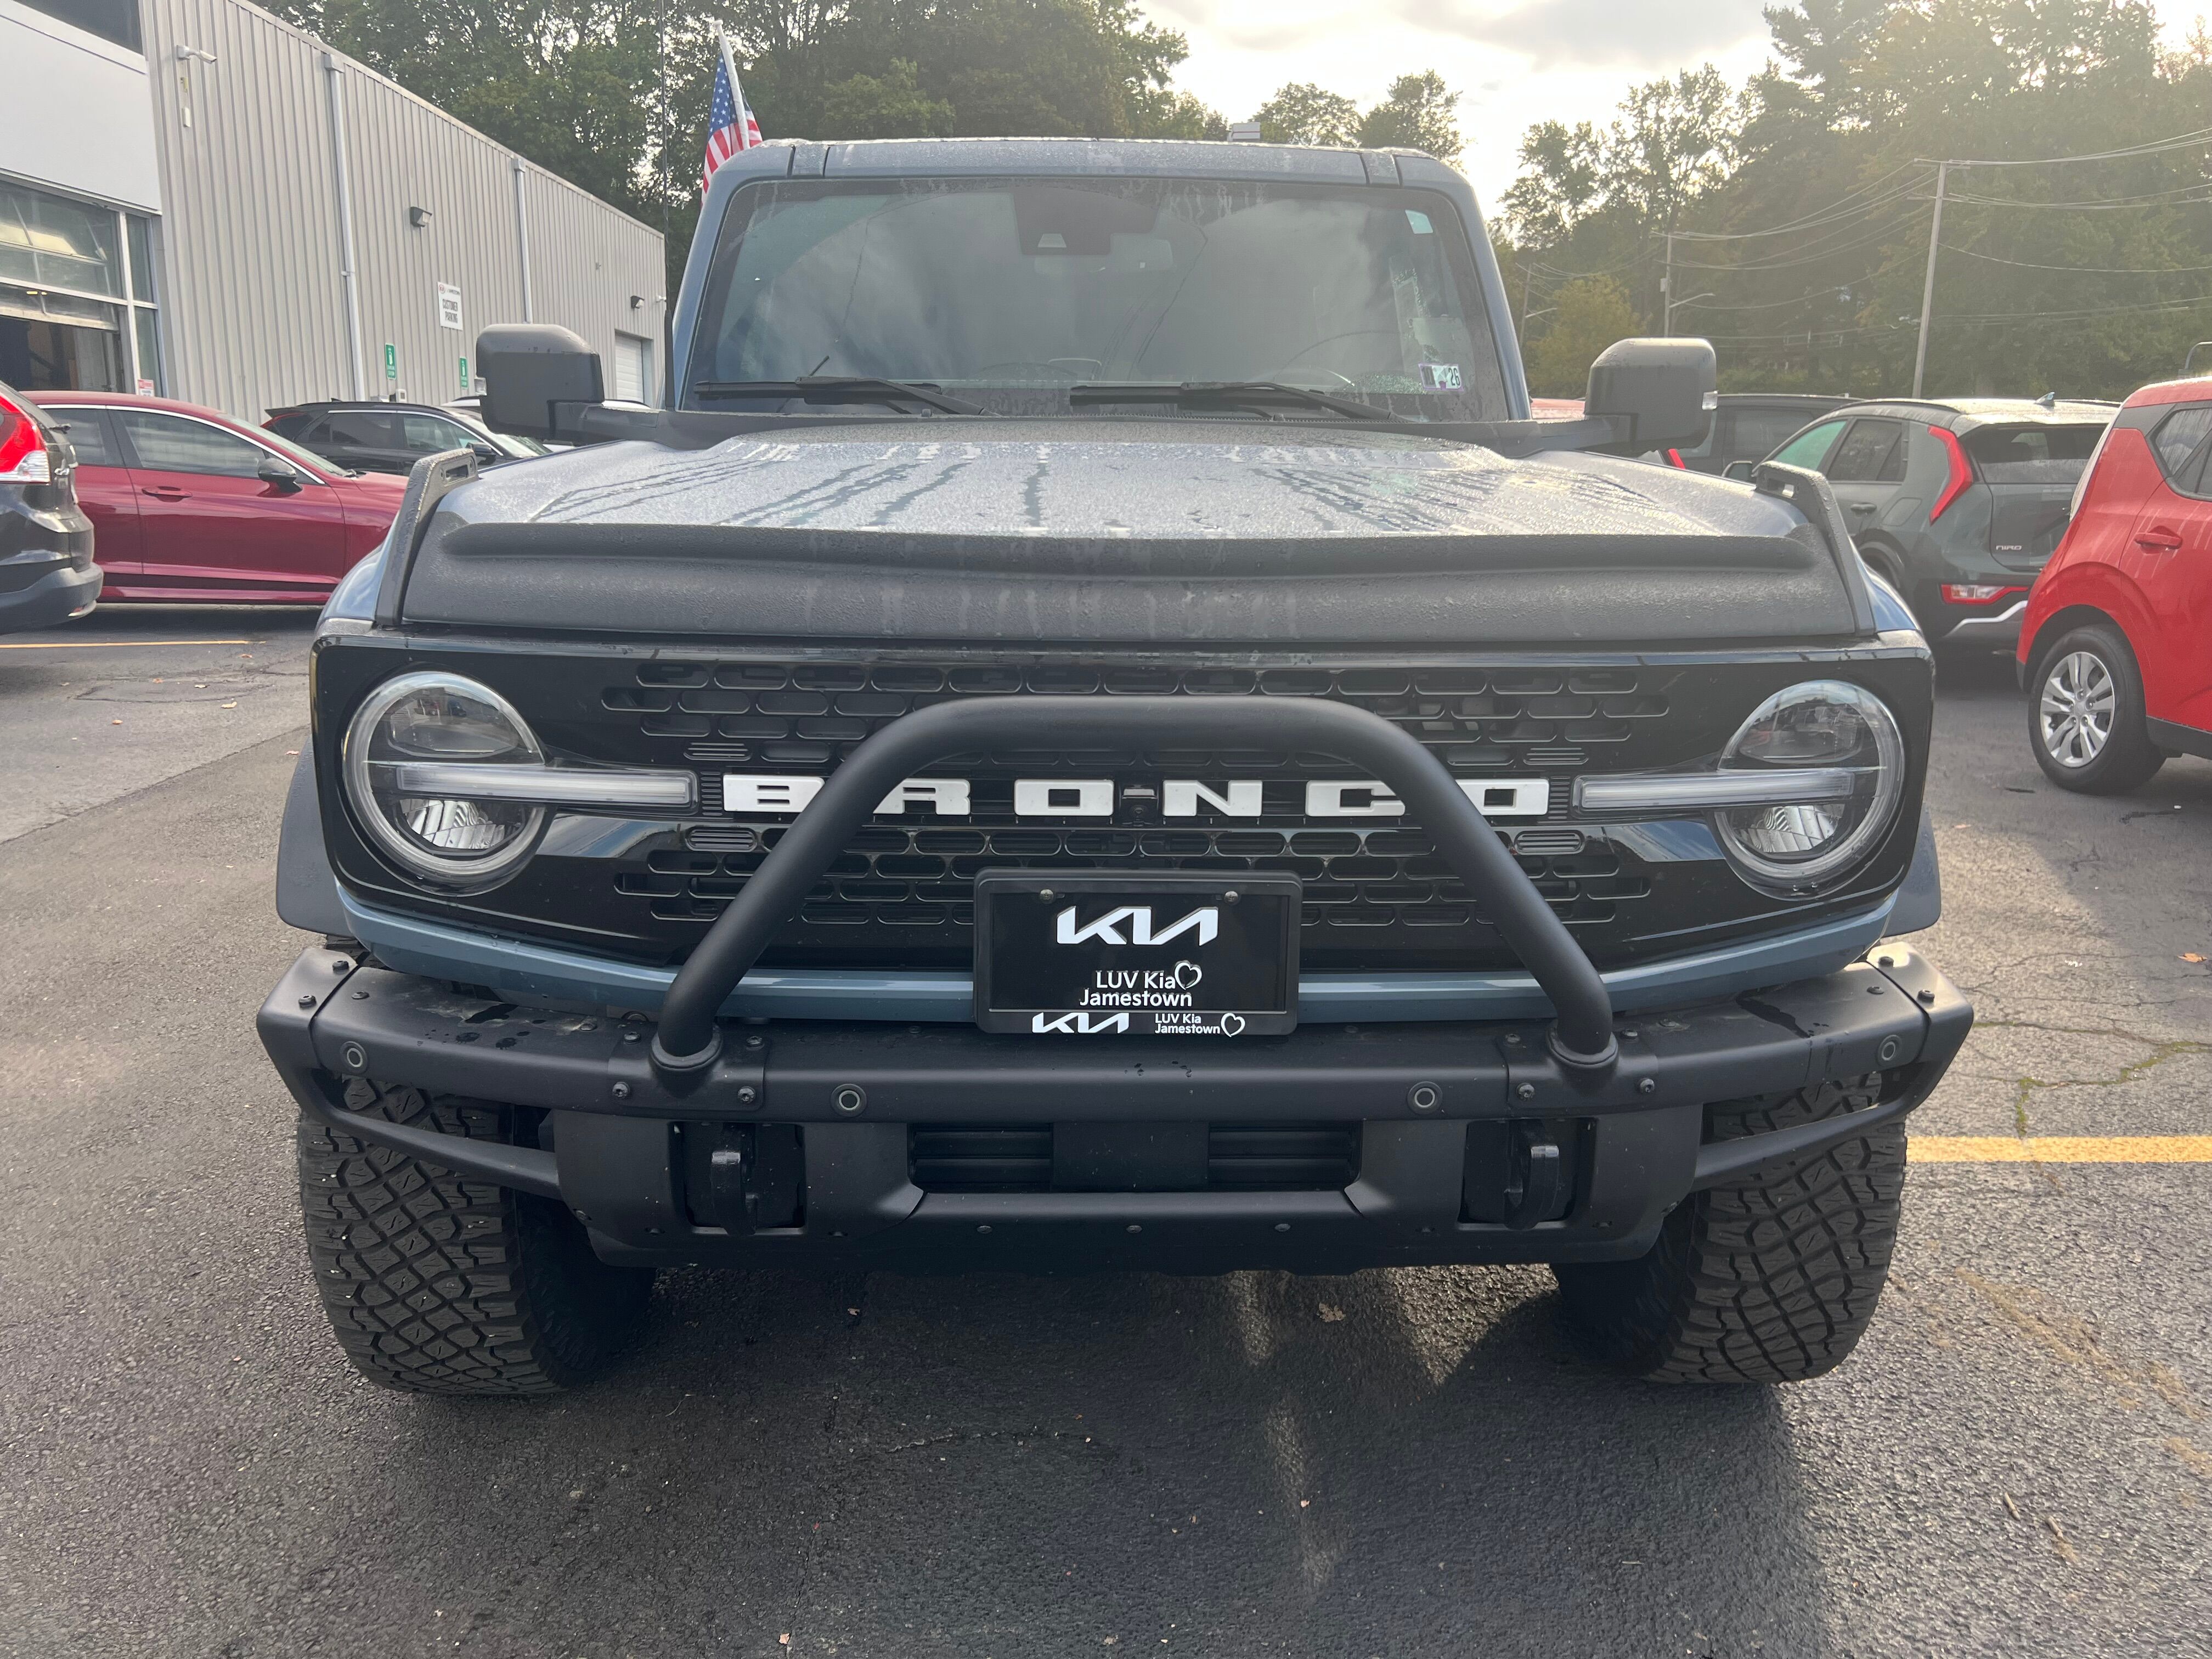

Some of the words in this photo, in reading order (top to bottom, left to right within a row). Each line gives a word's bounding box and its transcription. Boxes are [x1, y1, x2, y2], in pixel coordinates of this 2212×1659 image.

[1448, 368, 1460, 386] 26
[723, 773, 1549, 817] BRONCO
[1057, 905, 1218, 946] KIA
[1096, 971, 1138, 989] LUV
[1144, 971, 1175, 989] Kia
[1080, 989, 1192, 1007] Jamestown
[1032, 1012, 1130, 1034] KIA
[1155, 1013, 1180, 1024] LUV
[1183, 1013, 1201, 1024] Kia
[1155, 1023, 1221, 1035] Jamestown
